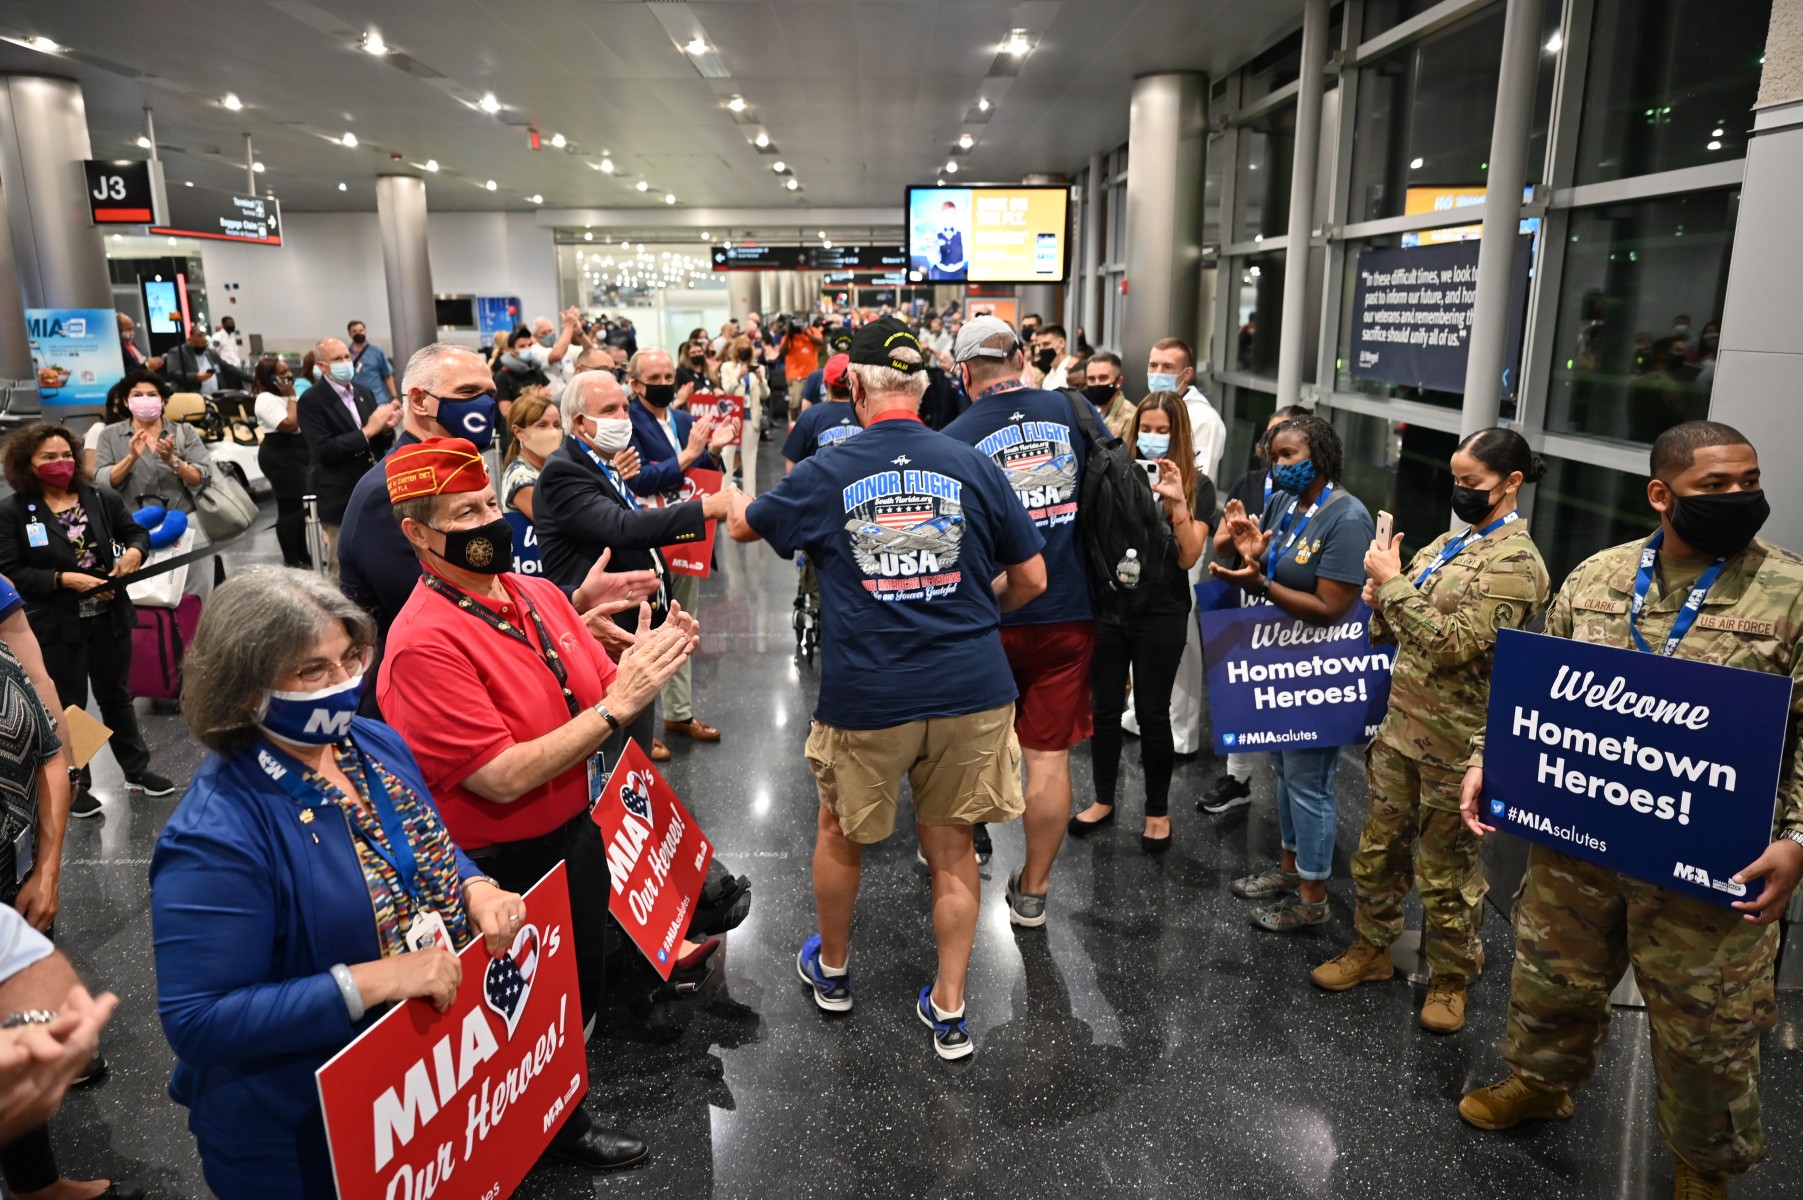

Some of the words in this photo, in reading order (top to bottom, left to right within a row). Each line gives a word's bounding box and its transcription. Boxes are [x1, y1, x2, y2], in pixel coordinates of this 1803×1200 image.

[93, 175, 126, 200] J3
[1373, 271, 1391, 286] these
[1391, 268, 1417, 285] difficult
[1417, 266, 1440, 286] times,
[1441, 269, 1453, 283] we
[1453, 264, 1472, 282] look
[1365, 292, 1378, 308] past
[1378, 290, 1386, 304] to
[1386, 288, 1408, 304] inform
[1408, 292, 1420, 304] our
[1420, 287, 1444, 305] future,
[1445, 286, 1462, 304] and
[27, 318, 65, 338] MIA
[1363, 311, 1374, 323] our
[1374, 309, 1400, 323] veterans
[1400, 307, 1415, 323] and
[1415, 307, 1466, 329] remembering
[1362, 325, 1387, 341] sacrifice
[1387, 326, 1410, 343] should
[1410, 327, 1429, 348] unify
[1428, 328, 1439, 345] all
[1439, 328, 1449, 346] of
[691, 403, 719, 417] MIA
[818, 425, 846, 446] HONOR
[975, 424, 1024, 457] HONOR
[1022, 421, 1070, 445] FLIGHT
[398, 475, 416, 484] CARTER
[418, 471, 431, 479] DET
[843, 470, 903, 514] HONOR
[903, 470, 962, 505] FLIGHT
[875, 496, 895, 505] South
[895, 495, 933, 505] Florida.org
[880, 548, 940, 577] USA
[878, 577, 920, 591] AMERICAN
[920, 571, 961, 587] VETERANS
[882, 592, 895, 600] are
[895, 589, 925, 601] Forever
[925, 583, 958, 602] Grateful
[1584, 599, 1616, 612] CLARKE
[1251, 620, 1363, 650] Welcome
[1701, 616, 1716, 628] U.S.
[1718, 619, 1736, 631] AIR
[1737, 620, 1772, 634] FORCE
[1227, 652, 1390, 684] Hometown
[1254, 678, 1368, 710] Heroes!
[1550, 665, 1710, 730] Welcome
[1238, 729, 1318, 746] #MIAsalutes
[1512, 706, 1738, 792] Hometown
[1537, 752, 1692, 826] Heroes!
[1507, 806, 1607, 853] #MIAsalutes
[607, 813, 650, 896] MIA
[628, 877, 659, 927] Our
[648, 801, 686, 887] Heroes!
[663, 895, 691, 953] #MIAsalutes
[373, 1004, 499, 1174] MIA
[542, 923, 561, 958] 's
[464, 993, 567, 1163] Heroes!
